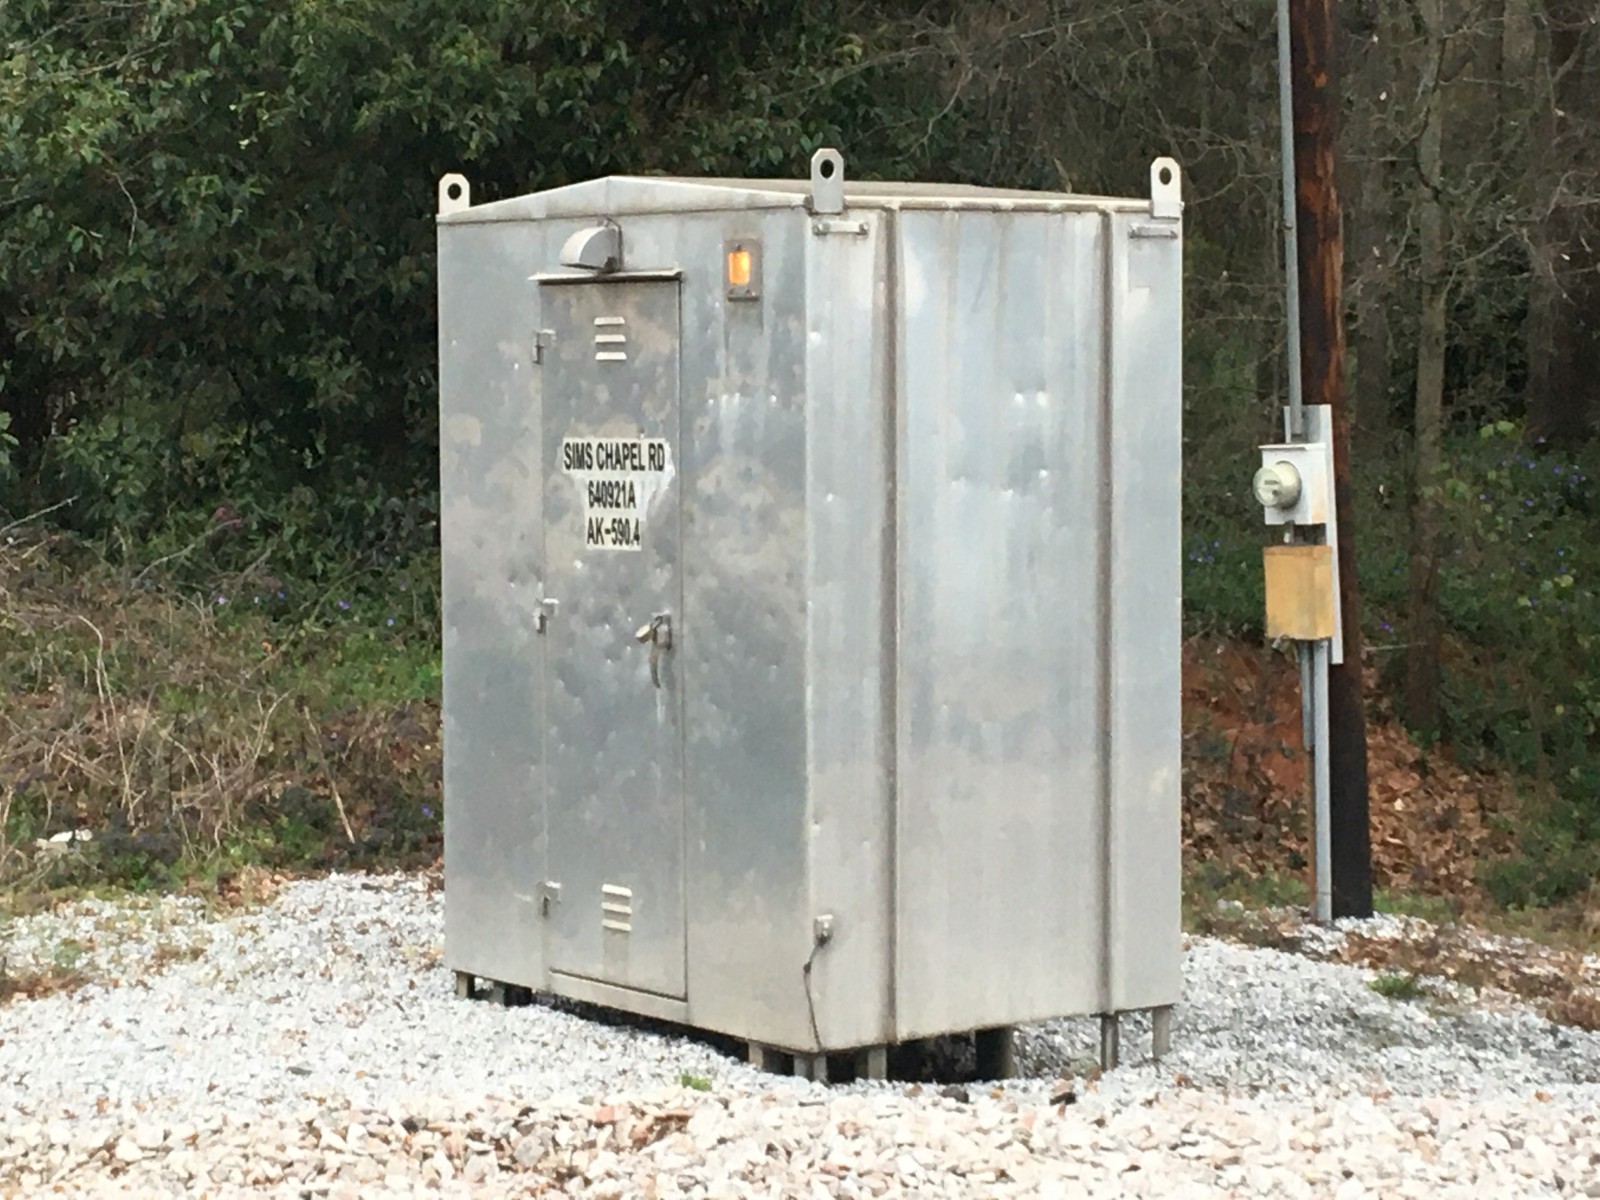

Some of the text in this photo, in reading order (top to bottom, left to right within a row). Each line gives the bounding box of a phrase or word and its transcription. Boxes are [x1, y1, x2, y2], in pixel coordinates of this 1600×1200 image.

[564, 442, 665, 472] SIMS CHAPEL RD
[588, 480, 636, 508] 640921A
